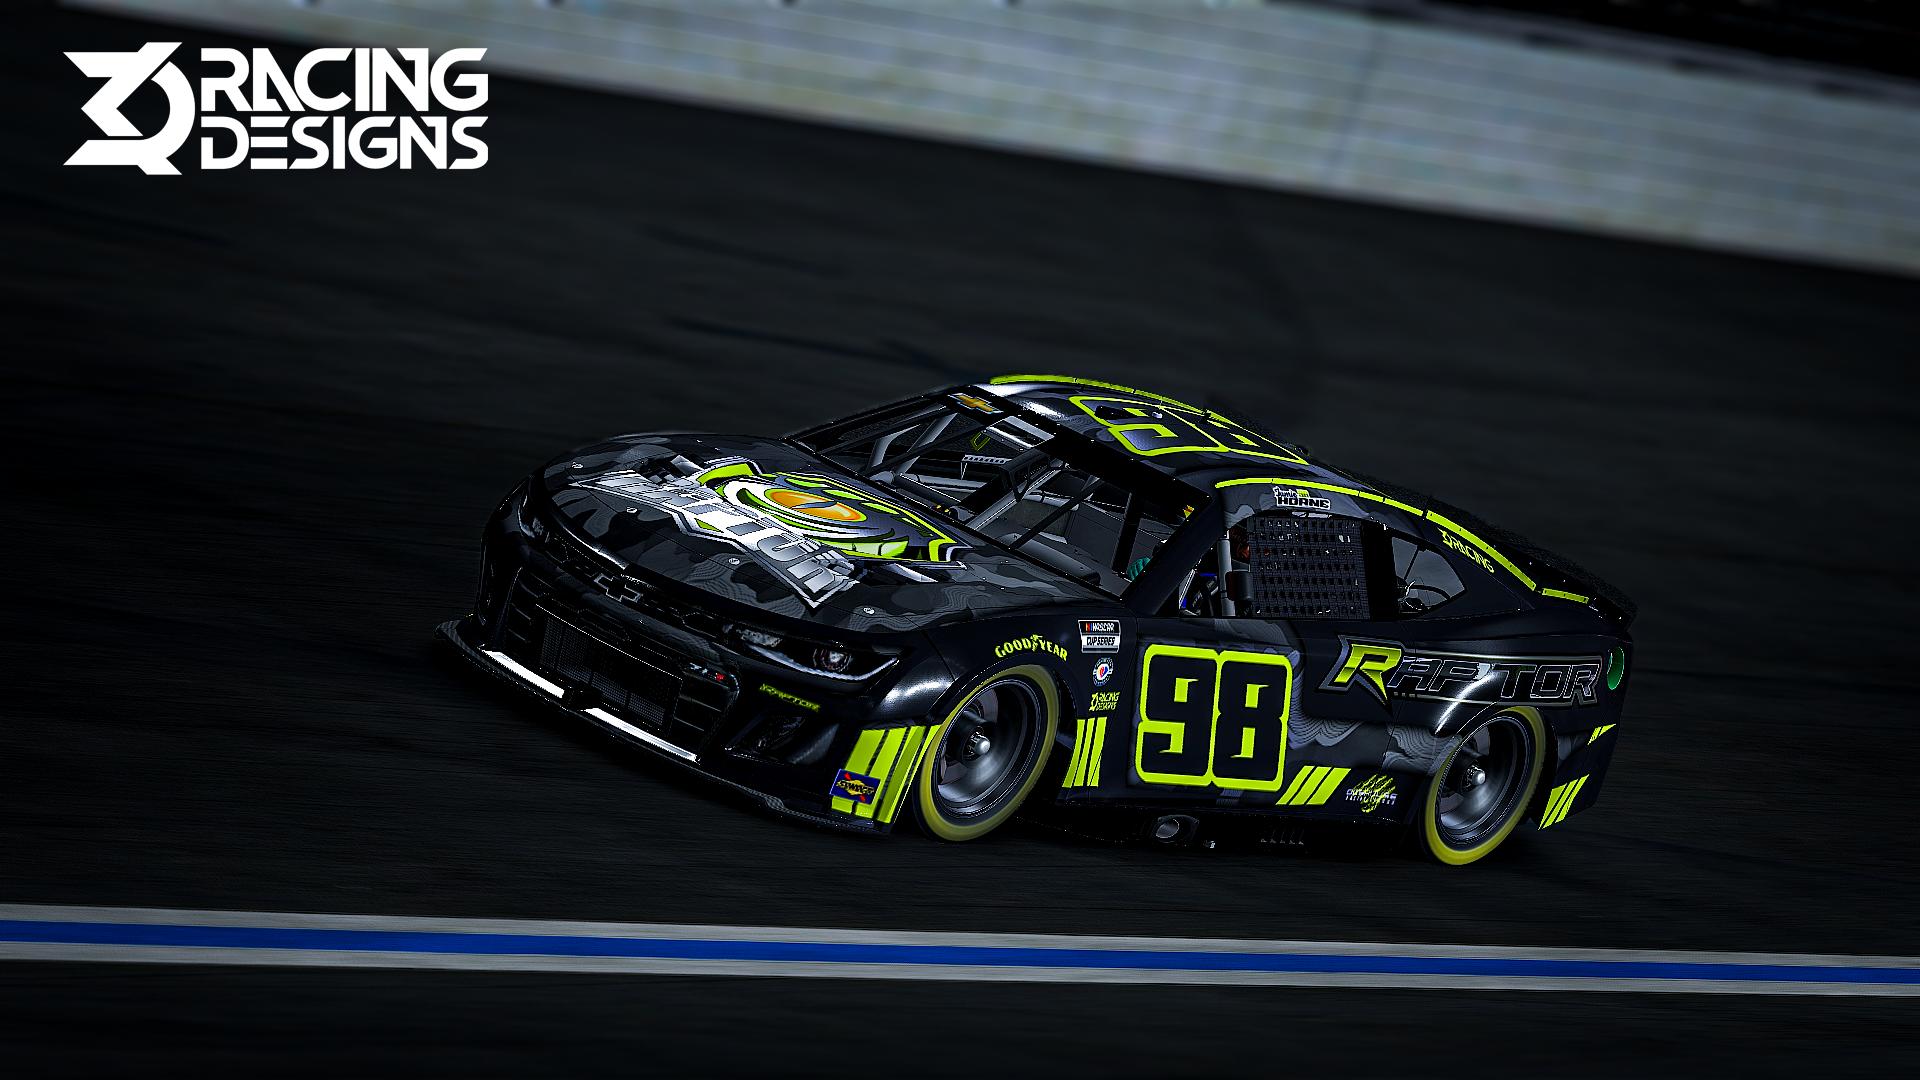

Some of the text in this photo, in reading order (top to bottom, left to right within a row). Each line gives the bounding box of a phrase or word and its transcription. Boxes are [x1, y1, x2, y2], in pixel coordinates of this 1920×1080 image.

[1276, 496, 1330, 510] HORNE
[1450, 535, 1495, 574] RACING
[1090, 622, 1115, 632] NASCAR
[994, 633, 1068, 662] GOODYEAR
[1330, 641, 1601, 704] RAPTOR
[1135, 643, 1293, 792] 98
